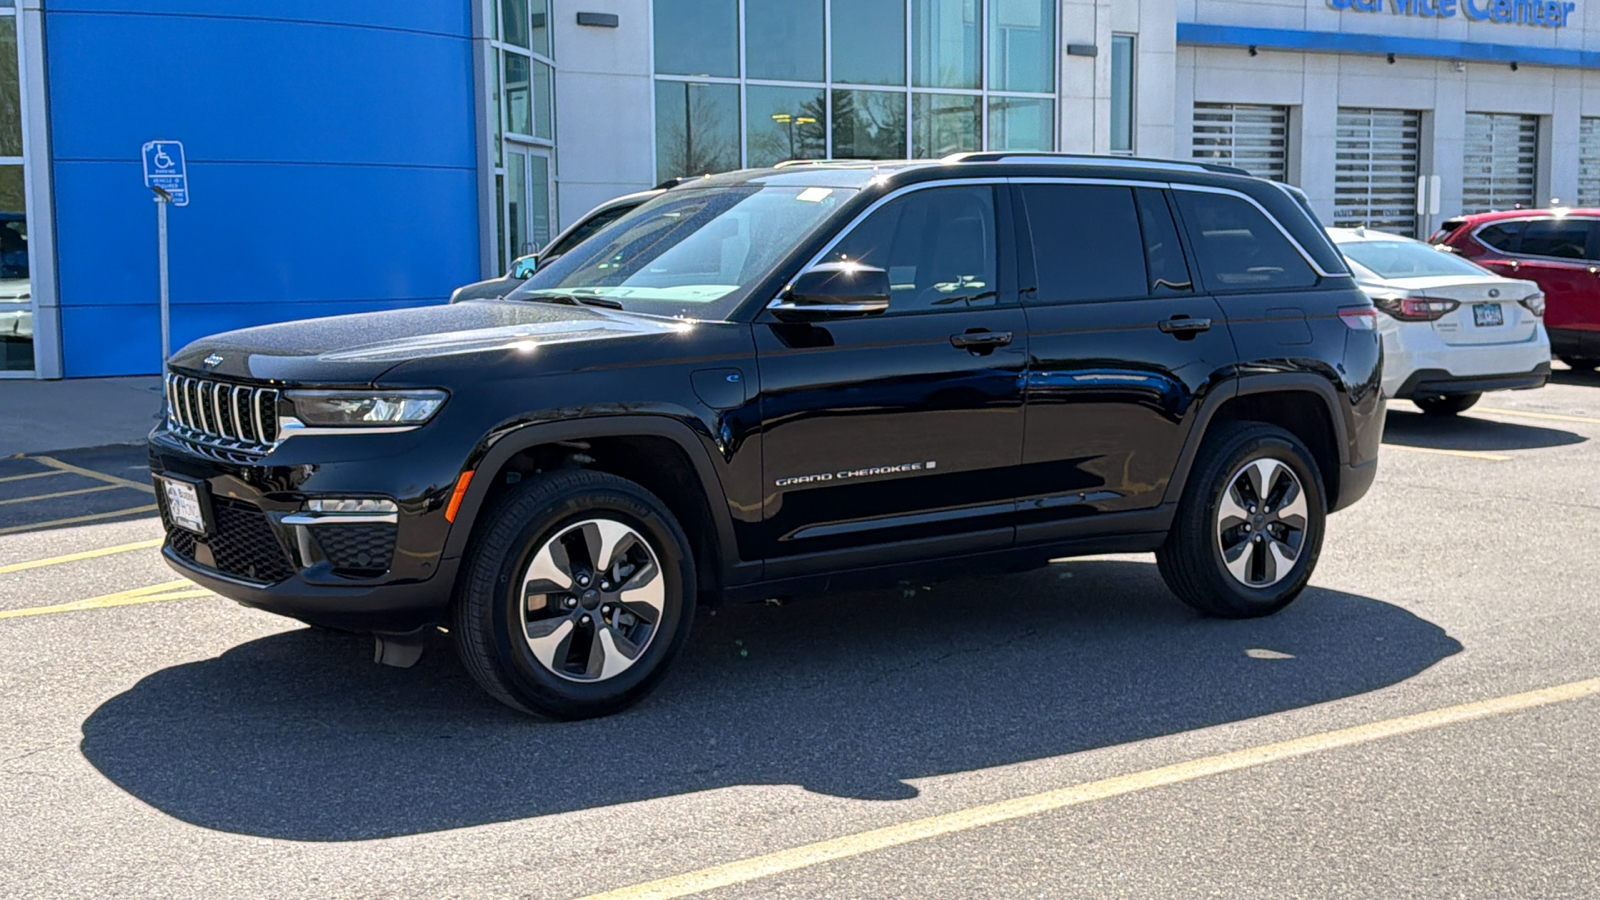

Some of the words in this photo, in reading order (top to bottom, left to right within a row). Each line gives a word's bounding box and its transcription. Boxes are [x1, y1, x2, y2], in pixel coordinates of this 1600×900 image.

[1463, 0, 1575, 27] Center
[775, 473, 833, 486] GRAND
[836, 462, 922, 479] CHEROKEE
